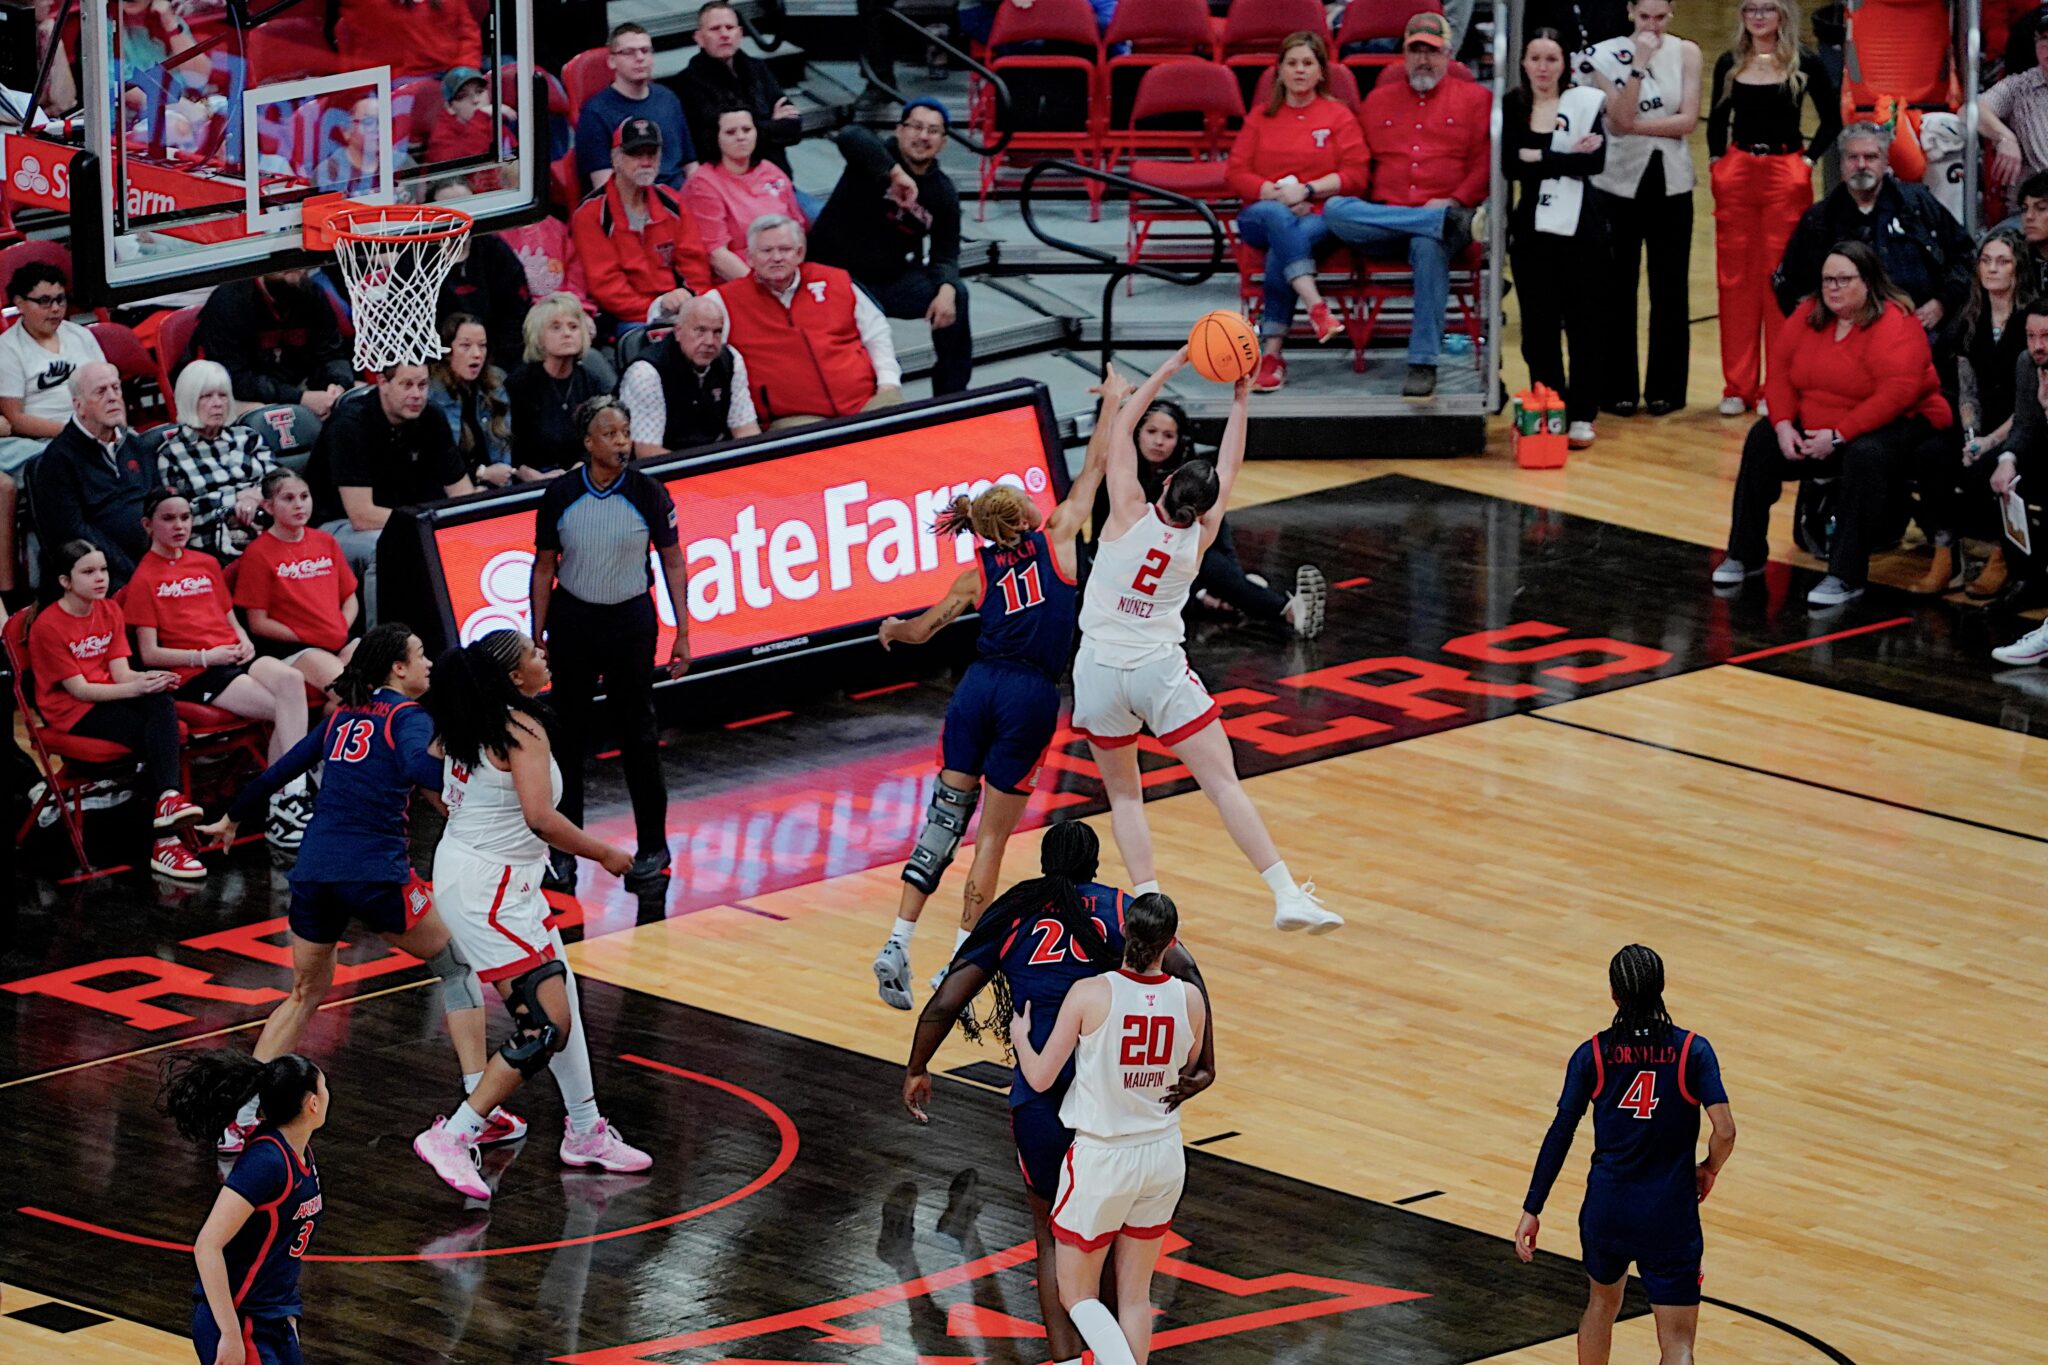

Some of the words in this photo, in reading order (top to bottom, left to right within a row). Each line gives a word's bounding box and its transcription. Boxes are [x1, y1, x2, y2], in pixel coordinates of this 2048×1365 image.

[126, 178, 176, 217] arm
[996, 560, 1046, 615] 11
[1131, 547, 1171, 596] 2
[329, 718, 375, 763] 13
[1120, 1014, 1175, 1066] 20
[1123, 1070, 1166, 1090] MAUPIN
[1617, 1070, 1660, 1119] 4
[288, 1220, 315, 1258] 3
